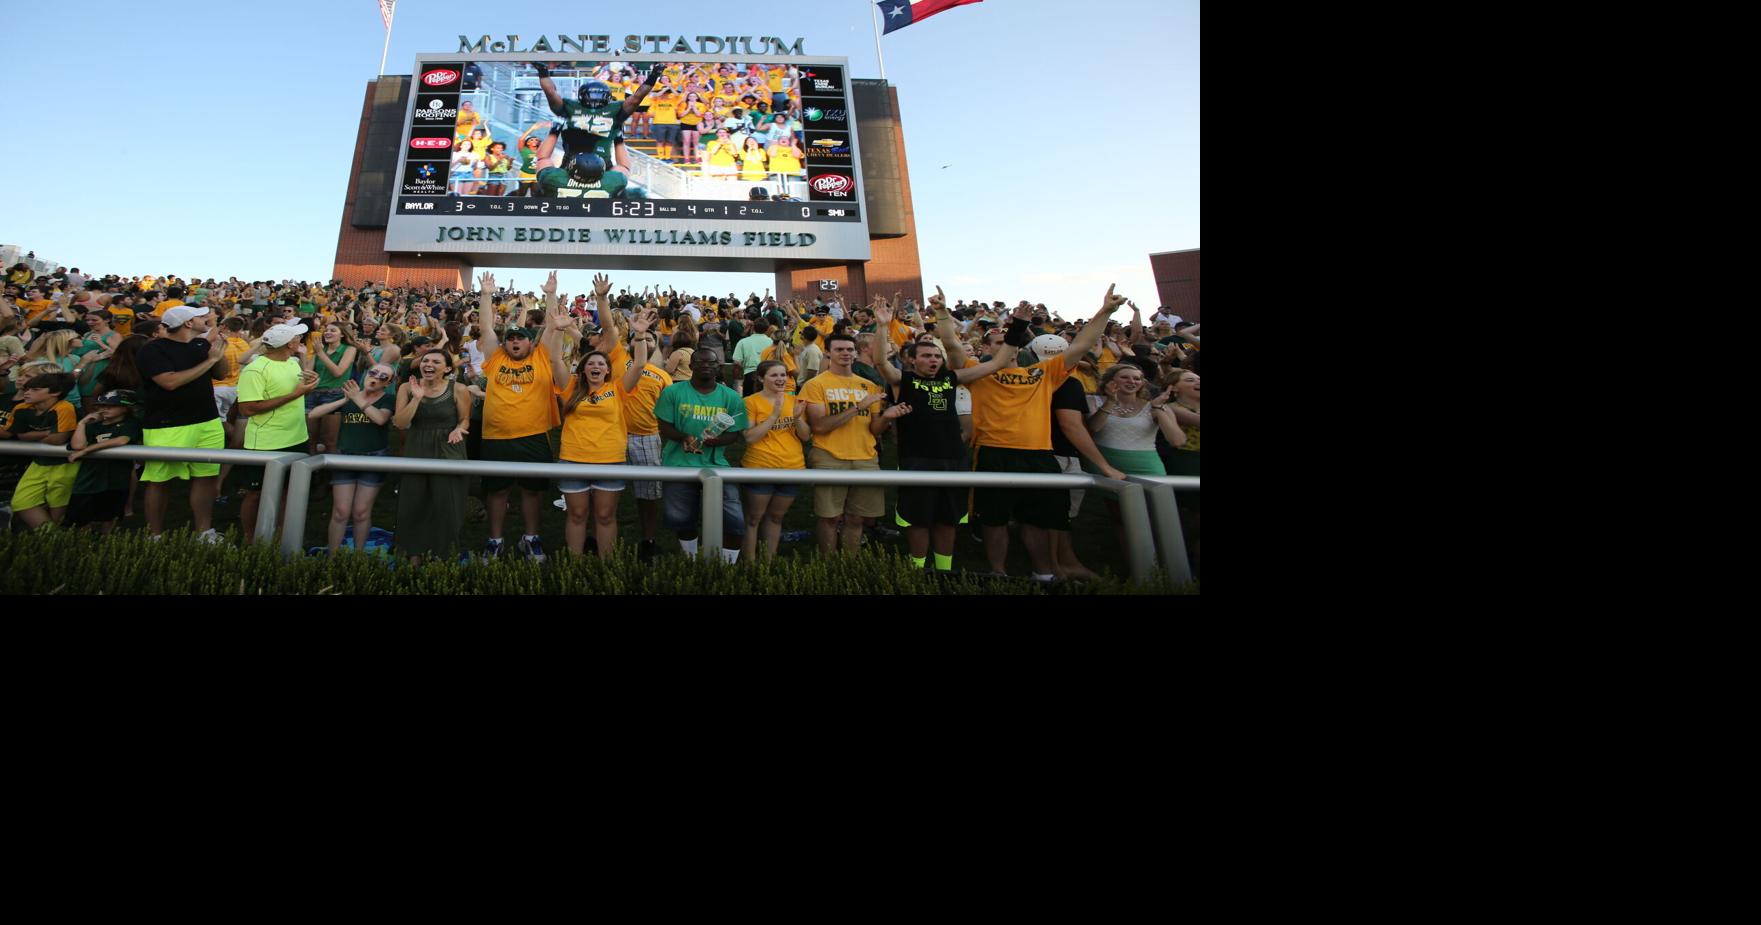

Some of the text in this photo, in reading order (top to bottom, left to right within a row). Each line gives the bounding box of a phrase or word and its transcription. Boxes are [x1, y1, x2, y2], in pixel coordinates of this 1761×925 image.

[457, 34, 807, 56] McLANE STADIUM
[415, 178, 436, 186] Baylor
[405, 202, 434, 210] BAYLOR
[455, 201, 463, 212] 3
[507, 202, 515, 212] 3
[540, 202, 550, 213] 2
[582, 203, 591, 213] 4
[612, 201, 654, 216] 6:23
[687, 205, 697, 215] 4
[724, 206, 729, 215] 1
[739, 206, 747, 216] 2
[801, 206, 810, 218] 0
[827, 208, 845, 217] SMU
[436, 226, 817, 248] JOHN EDDIE WILLIAMS FIELD
[821, 280, 838, 290] 25
[499, 364, 535, 376] BAYLOR
